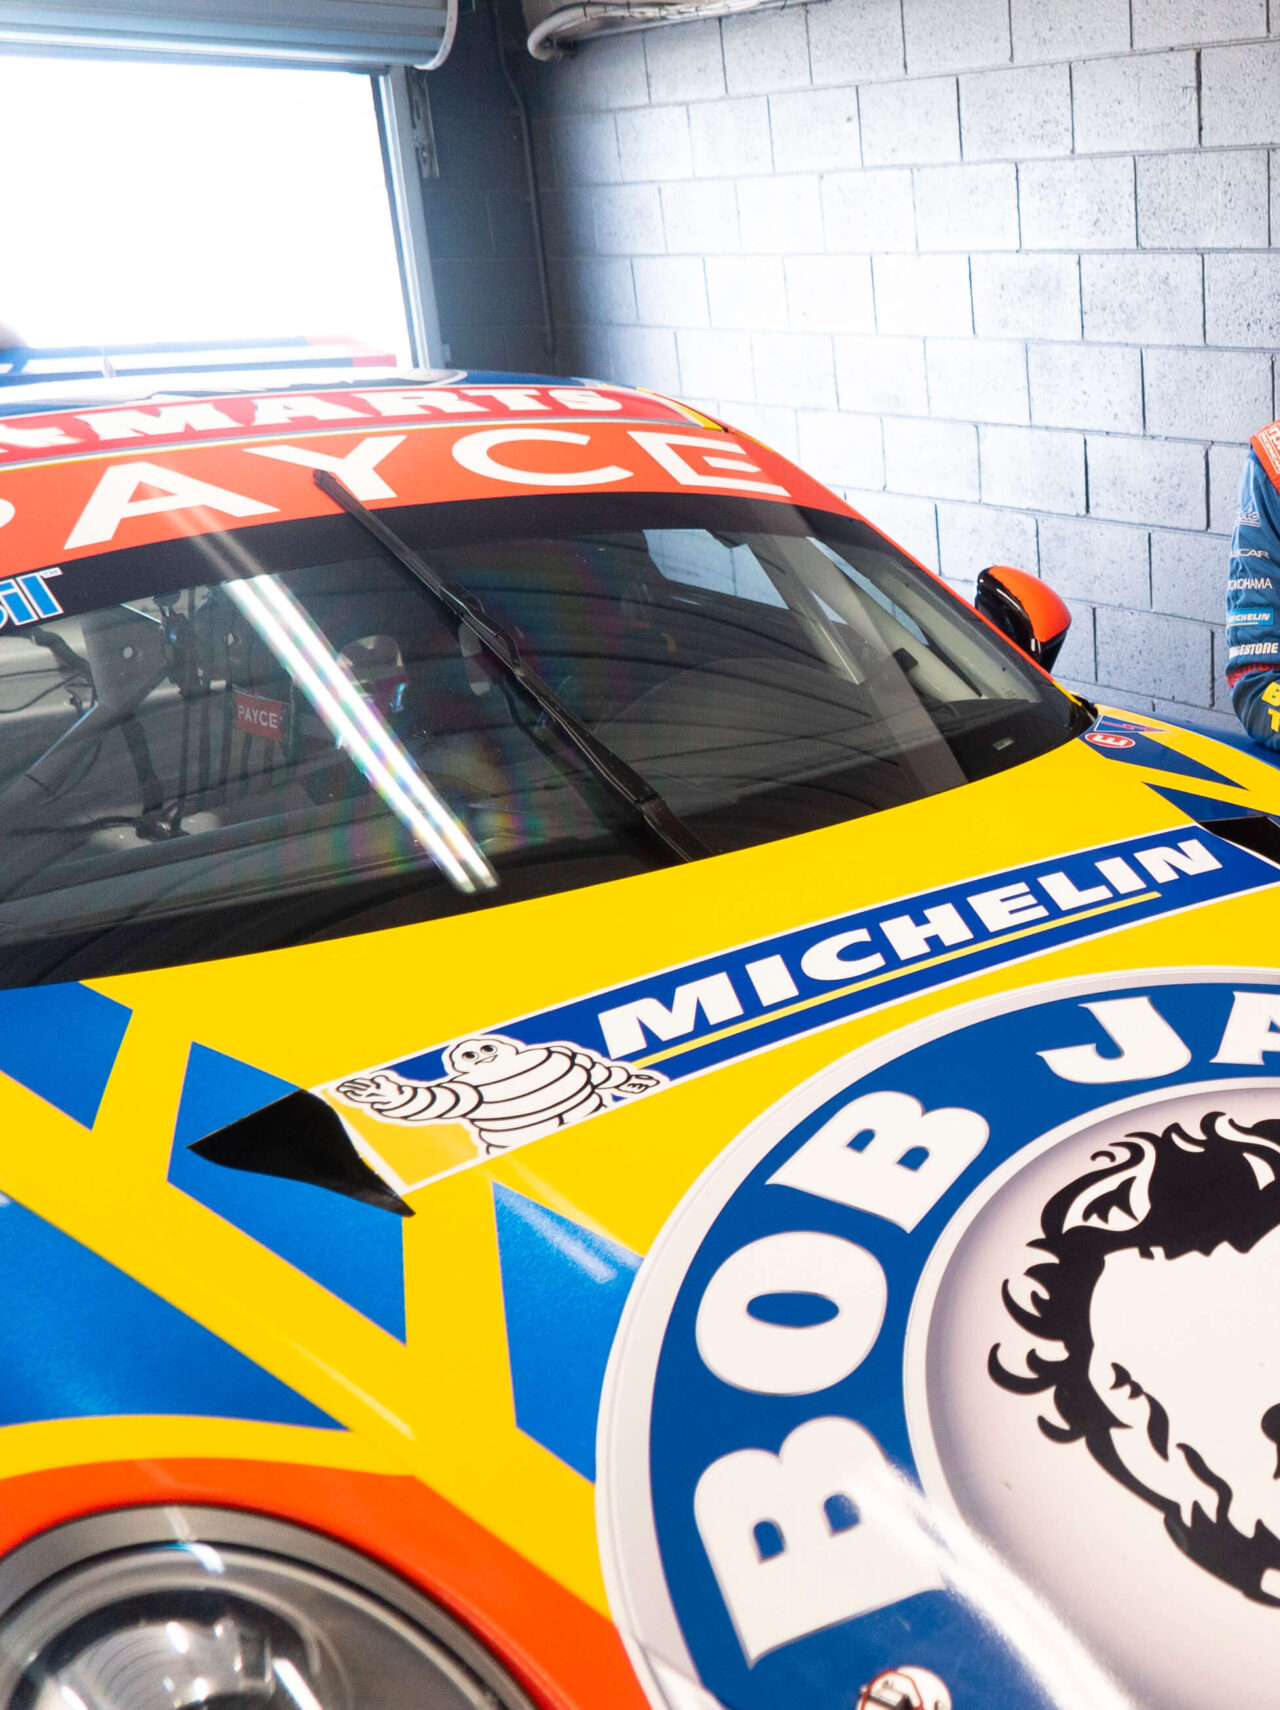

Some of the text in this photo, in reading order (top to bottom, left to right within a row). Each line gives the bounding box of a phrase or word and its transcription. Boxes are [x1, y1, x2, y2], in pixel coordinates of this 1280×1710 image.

[74, 388, 623, 441] MARTS
[0, 428, 792, 550] AYCE
[1230, 548, 1270, 559] CAR
[0, 572, 64, 629] il
[1229, 642, 1279, 659] ESTONE
[237, 704, 278, 729] PAYCE
[597, 838, 1223, 1061] MICHELIN
[693, 1089, 990, 1671] BOB
